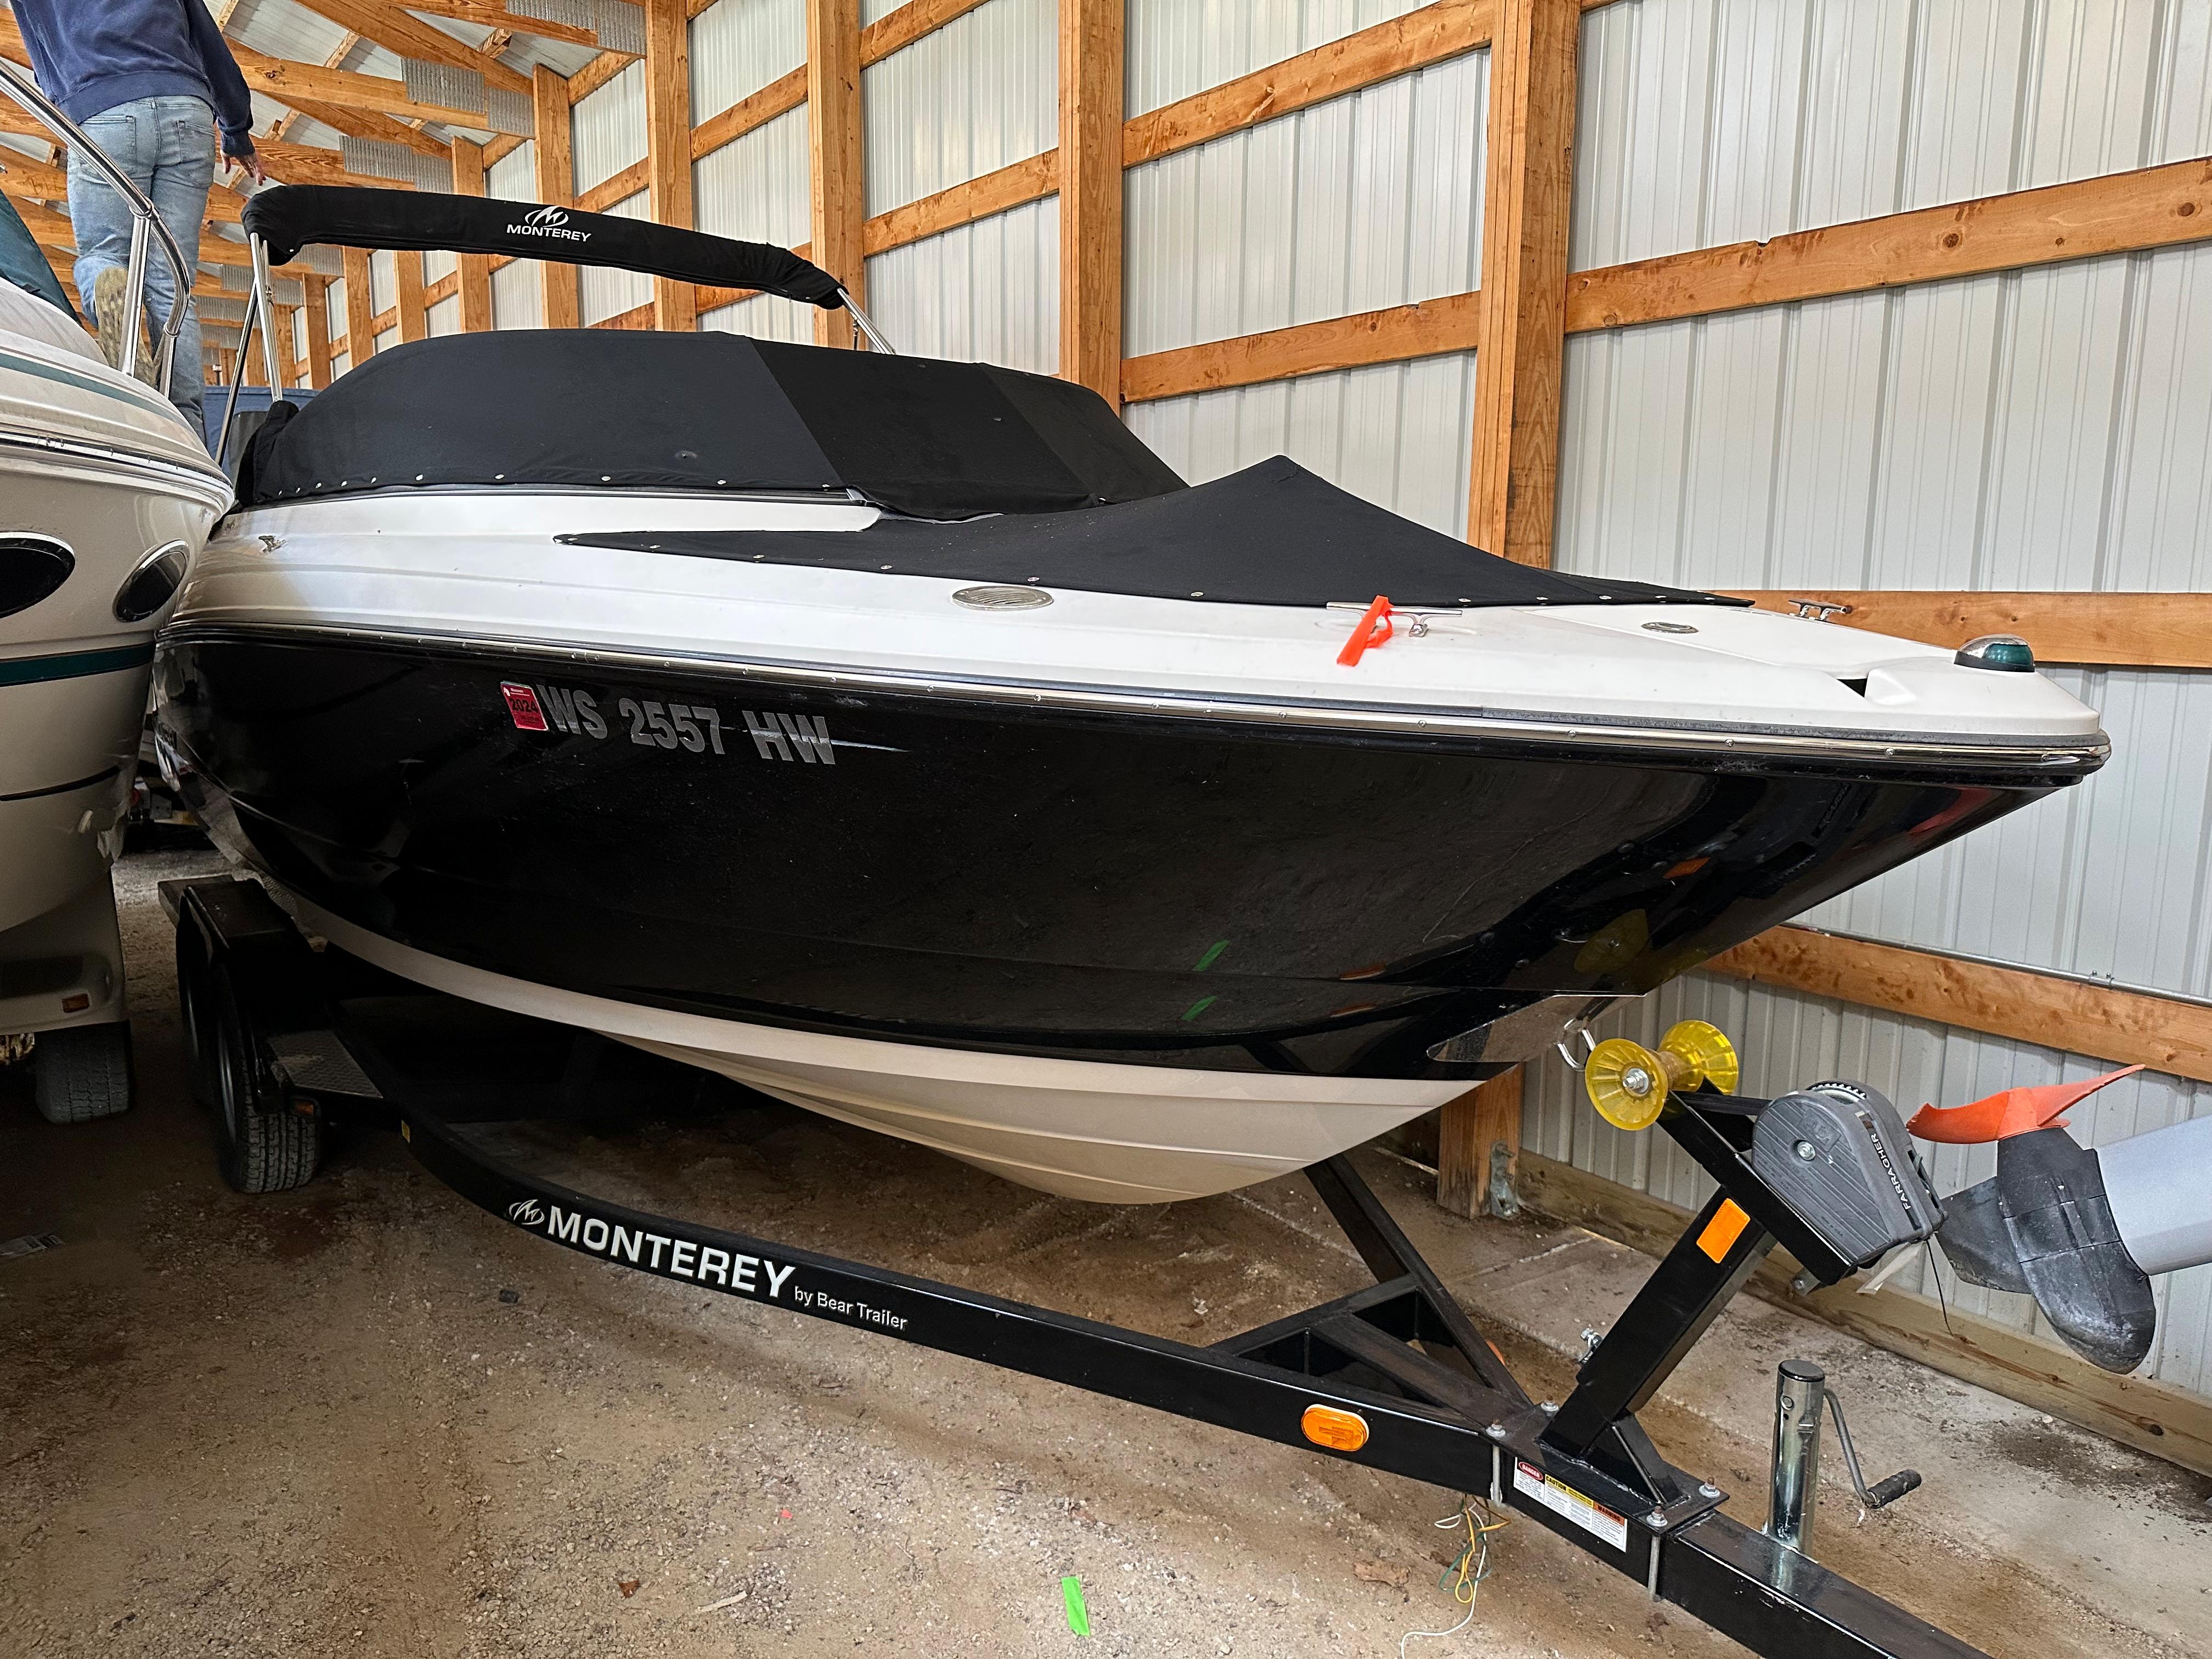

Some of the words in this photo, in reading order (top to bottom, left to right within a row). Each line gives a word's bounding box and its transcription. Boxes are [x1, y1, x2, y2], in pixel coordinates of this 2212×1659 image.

[506, 224, 591, 242] MONTEREY
[509, 698, 539, 713] 2024
[537, 685, 607, 740] WS
[618, 697, 725, 754] 2557
[742, 710, 836, 764] HW
[1871, 1132, 1911, 1210] FARRAGHER
[548, 1205, 795, 1297] MONTEREY
[794, 1285, 814, 1307] by
[817, 1293, 854, 1315] Bear
[856, 1302, 908, 1330] Trailer
[1545, 1476, 1566, 1492] CAUTION
